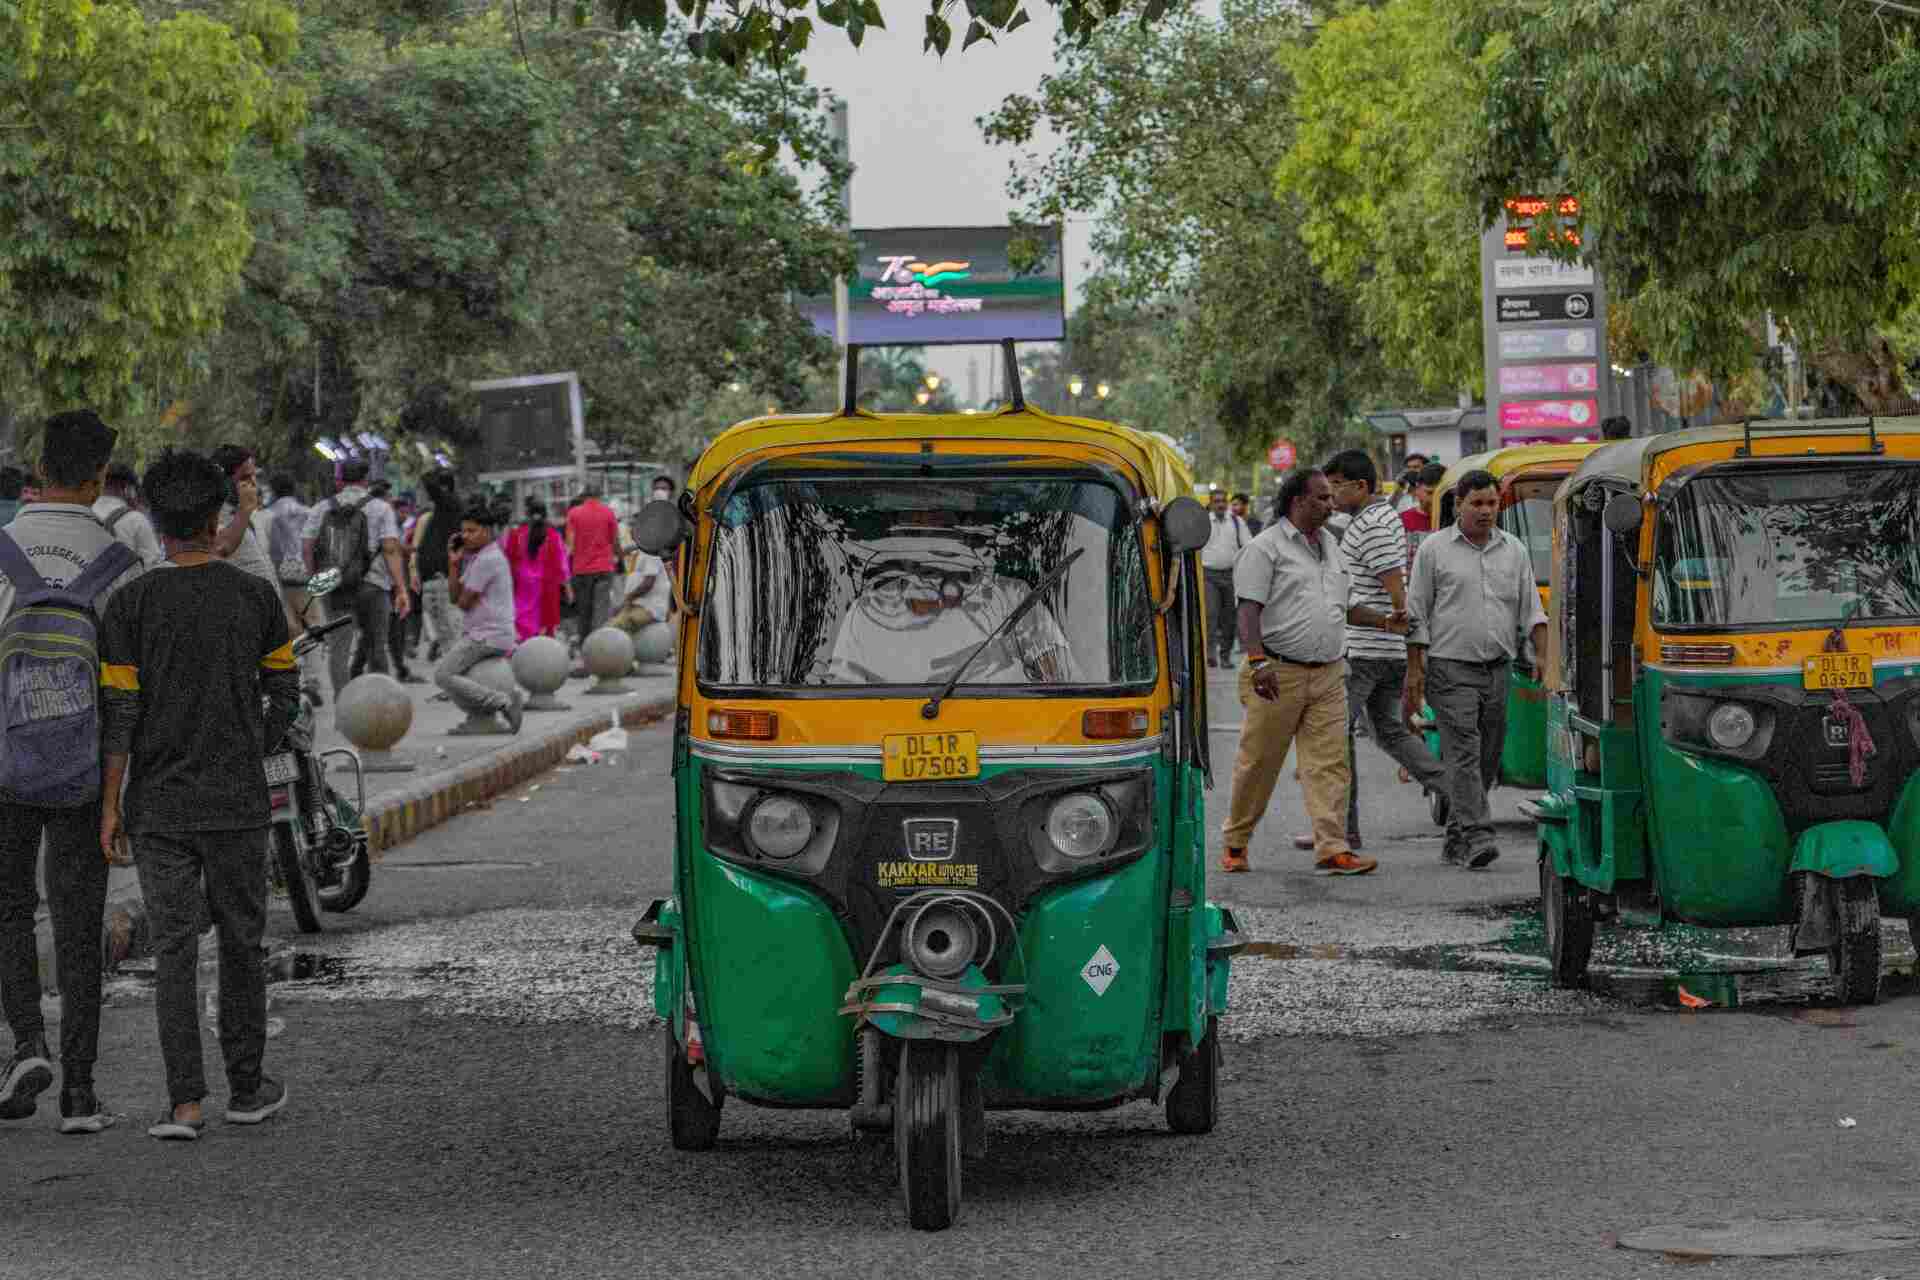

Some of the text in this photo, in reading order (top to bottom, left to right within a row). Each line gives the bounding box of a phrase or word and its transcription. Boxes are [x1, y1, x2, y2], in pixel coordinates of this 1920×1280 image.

[913, 832, 949, 852] RE
[879, 862, 937, 877] KAKKAR
[1088, 963, 1112, 977] CNG
